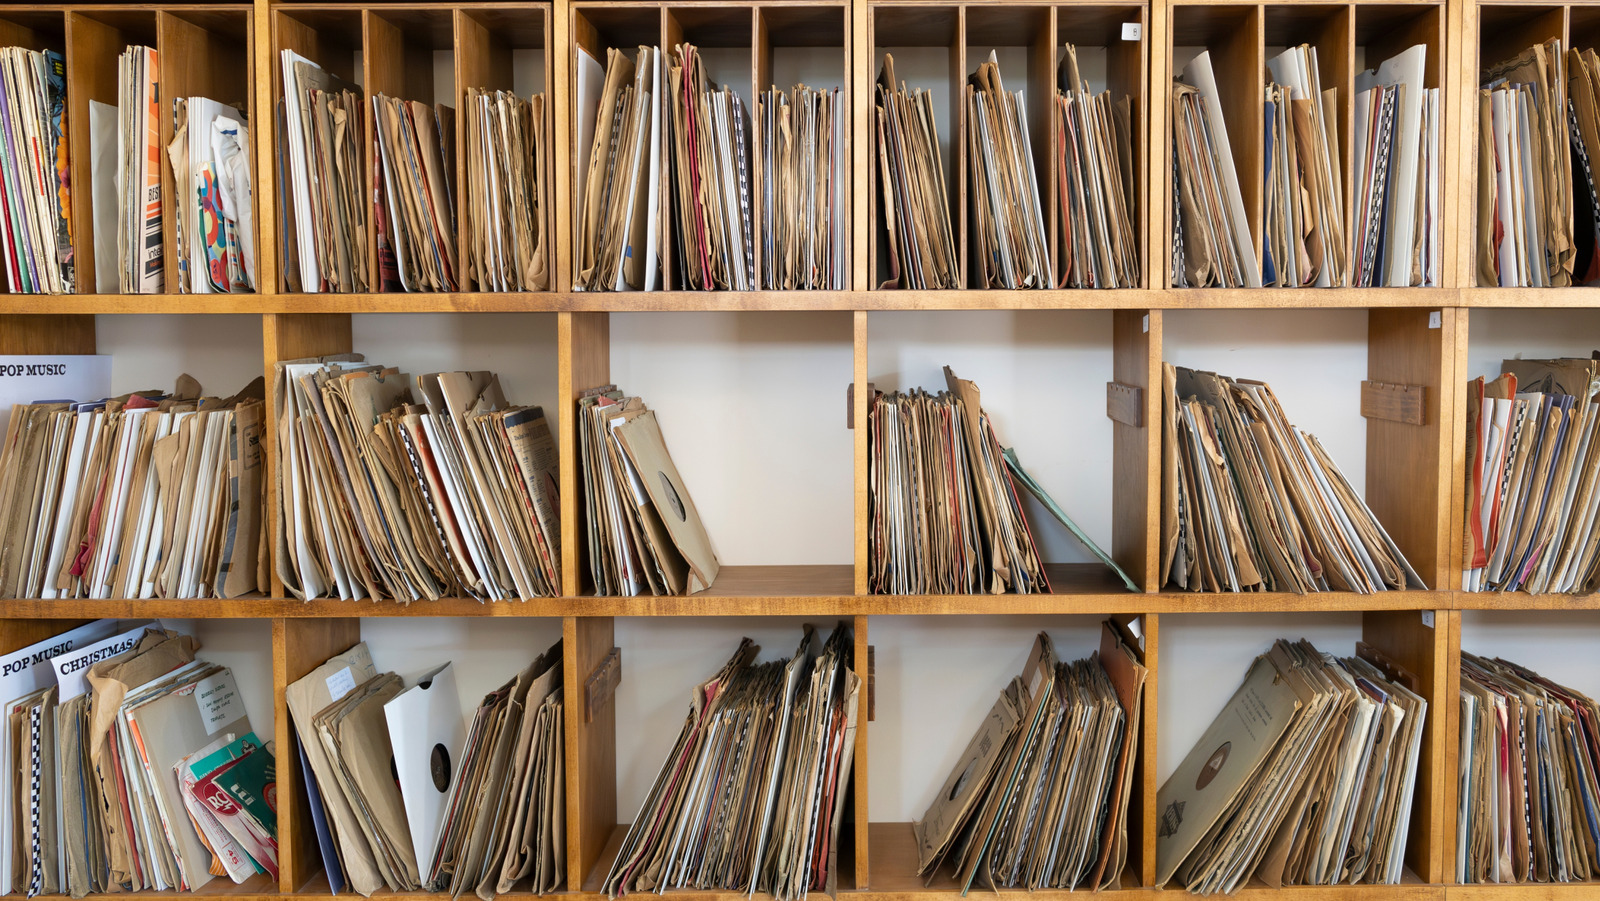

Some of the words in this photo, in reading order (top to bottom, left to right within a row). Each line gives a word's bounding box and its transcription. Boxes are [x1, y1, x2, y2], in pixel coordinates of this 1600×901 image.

[0, 364, 24, 377] POP
[26, 363, 66, 376] MUSIC
[3, 656, 29, 677] POP
[32, 640, 73, 666] MUSIC
[60, 638, 133, 675] CHRISTMAS
